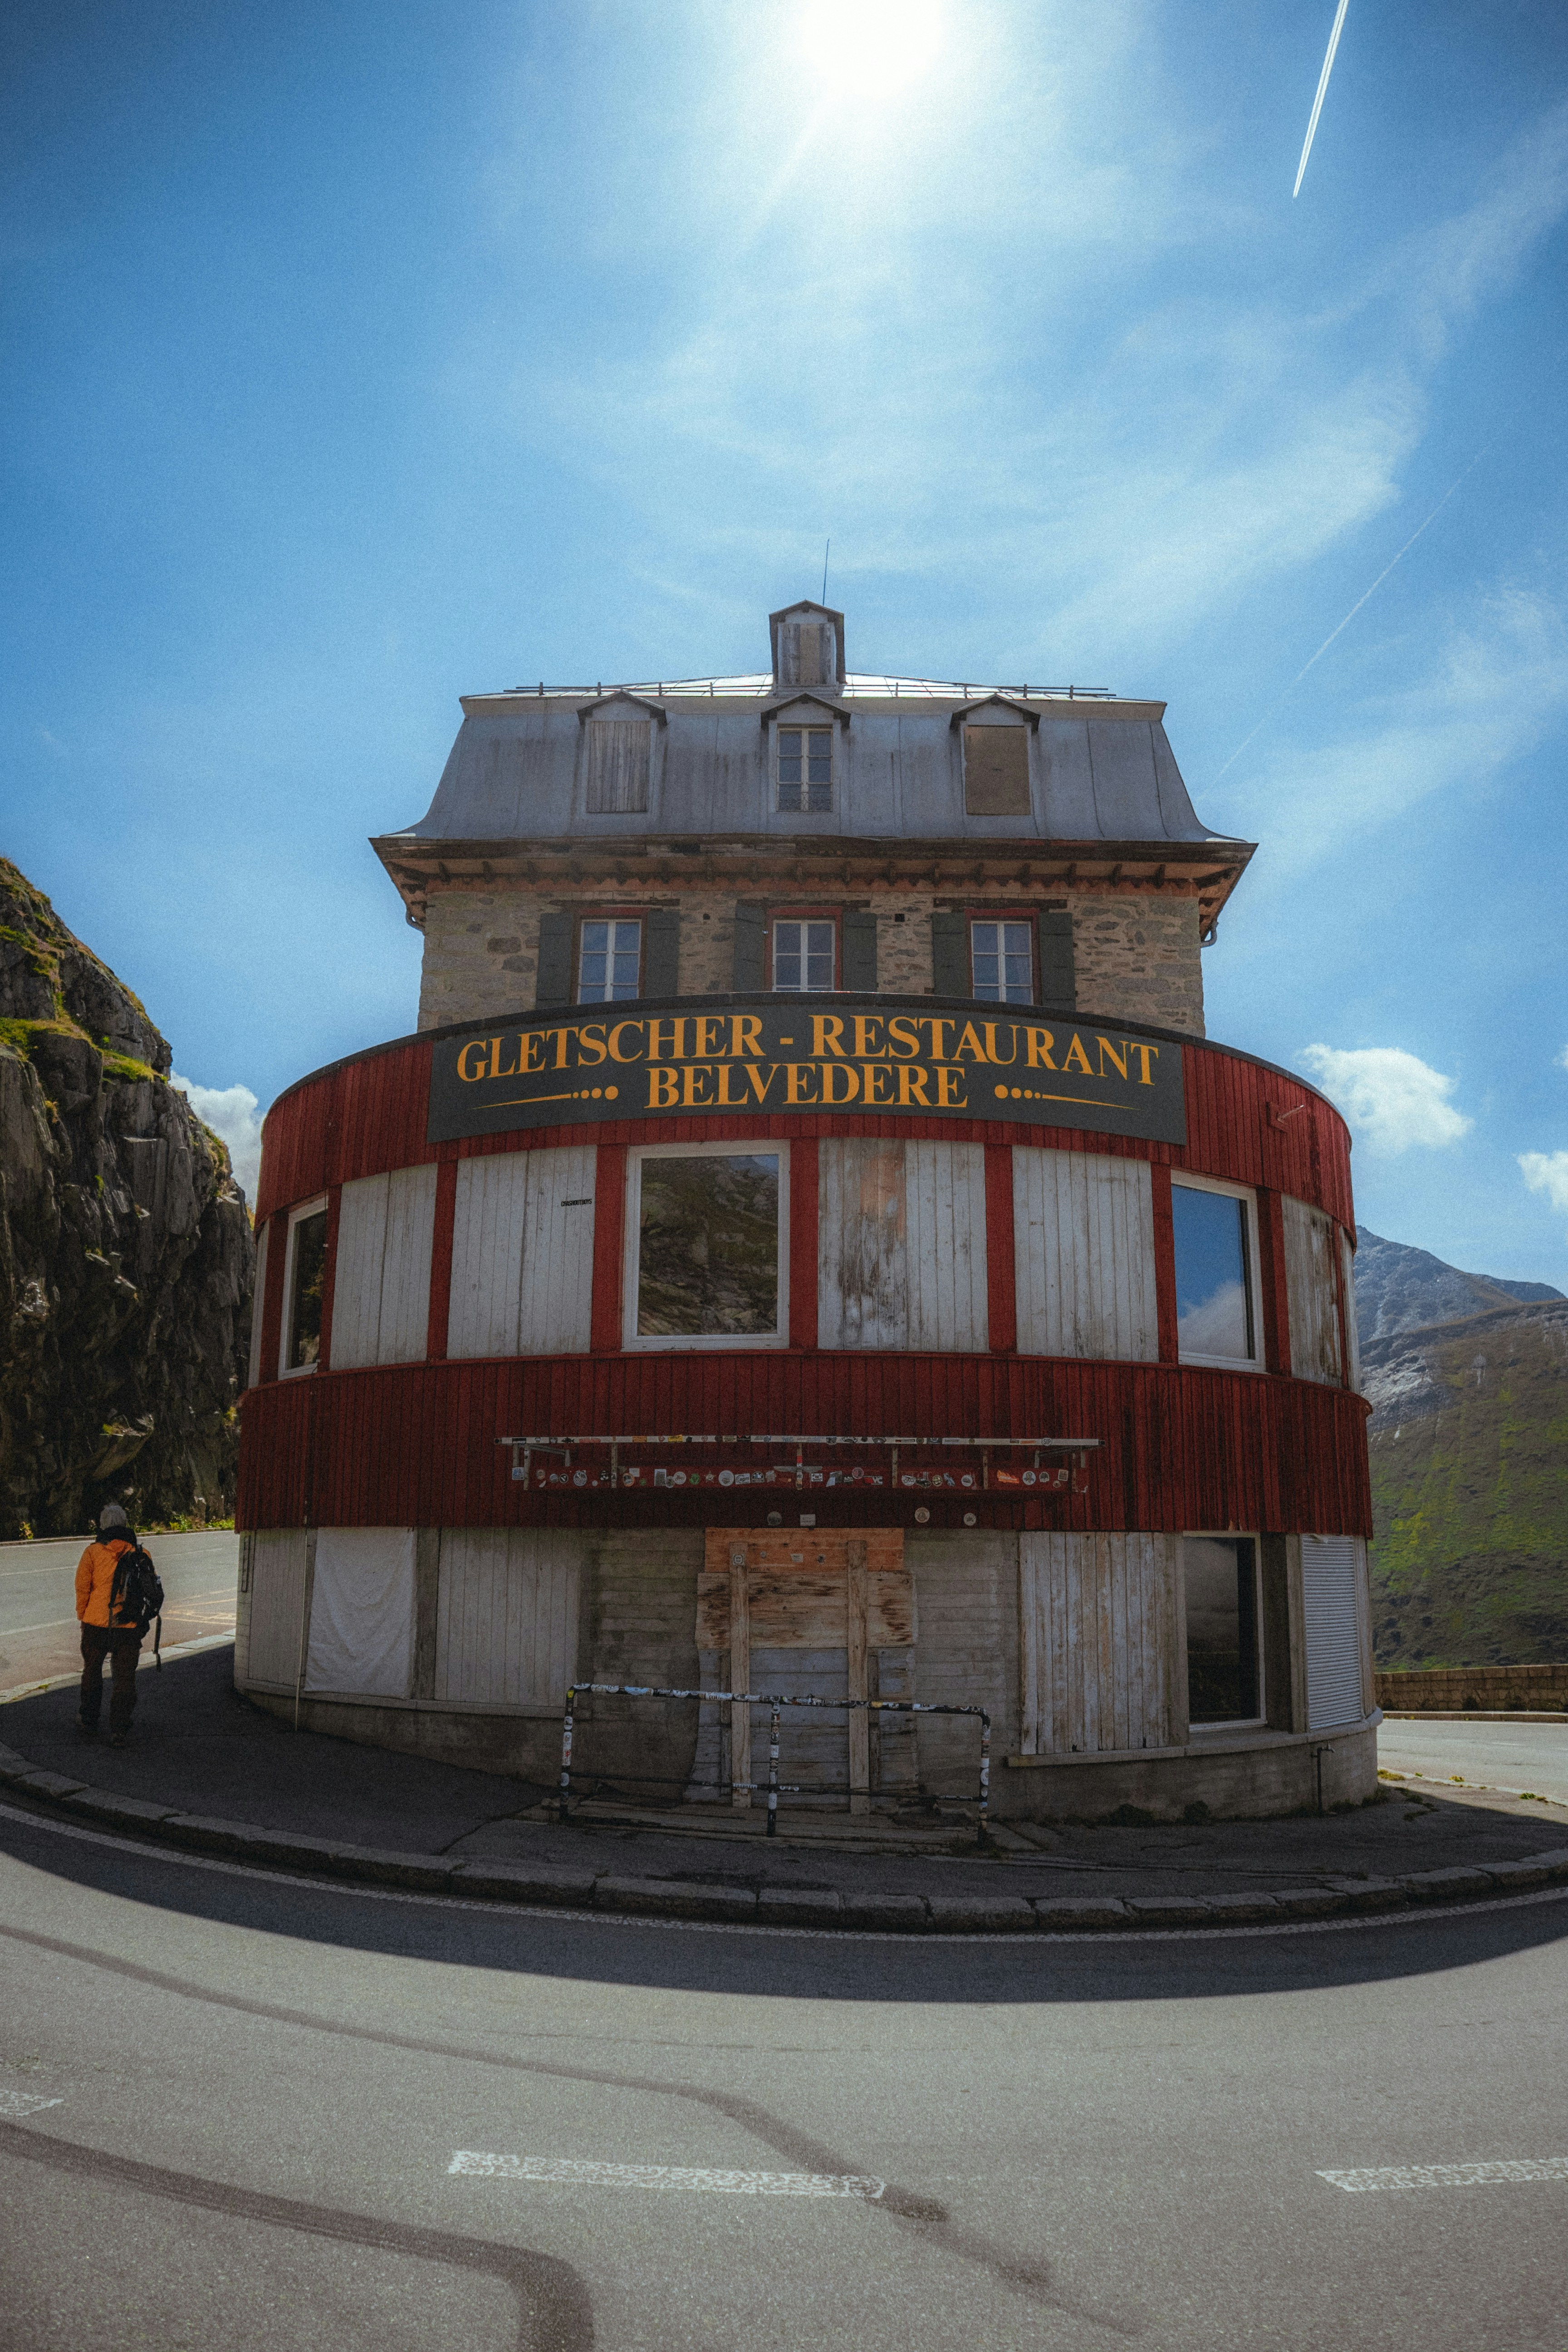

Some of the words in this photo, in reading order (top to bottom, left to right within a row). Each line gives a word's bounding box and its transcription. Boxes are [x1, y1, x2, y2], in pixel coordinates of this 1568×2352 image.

[457, 1015, 766, 1082] GLETSCHER
[810, 1015, 1159, 1086] RESTAURANT
[645, 1063, 968, 1108] BELVEDERE
